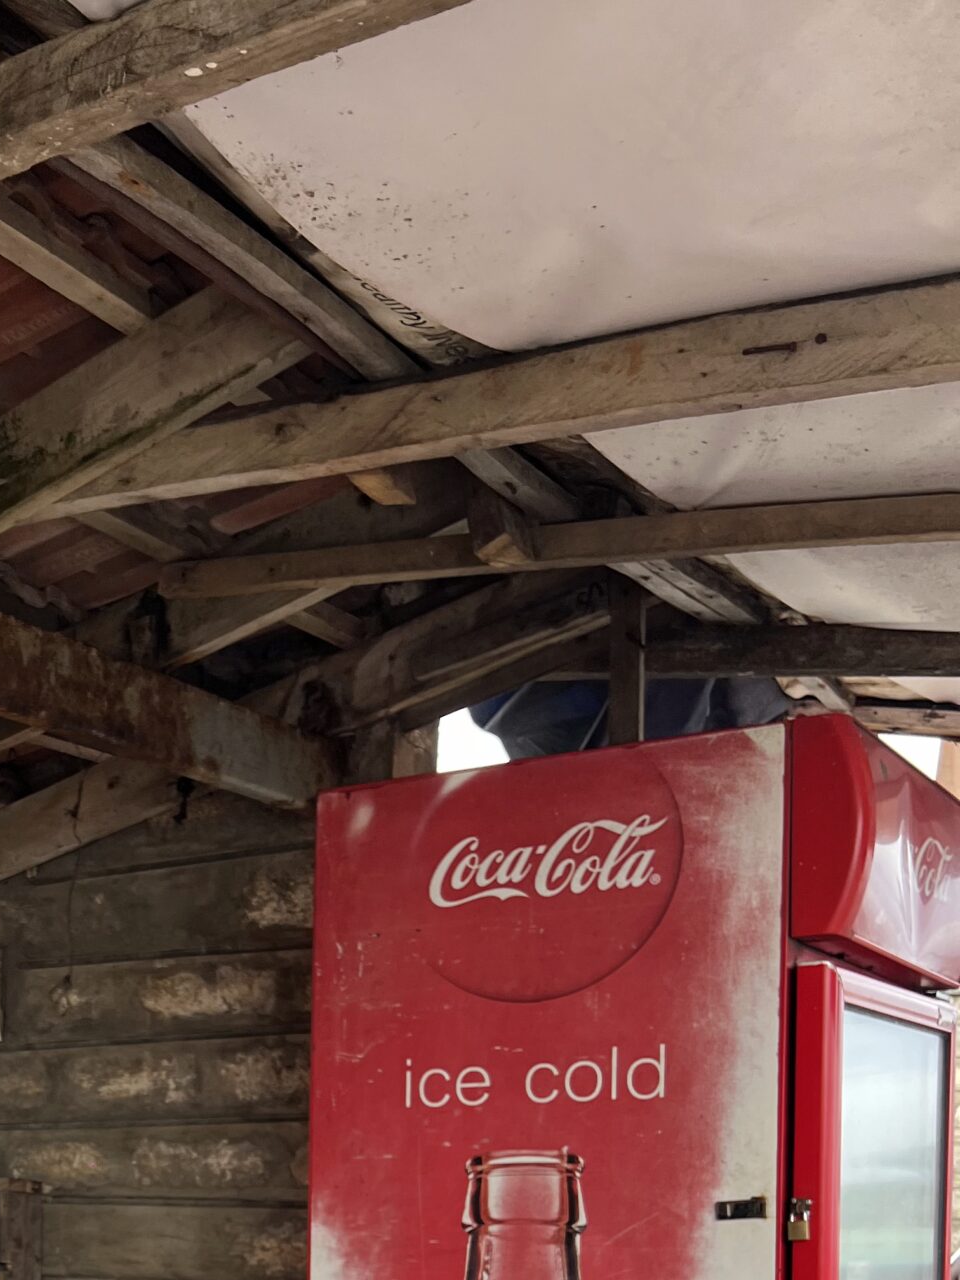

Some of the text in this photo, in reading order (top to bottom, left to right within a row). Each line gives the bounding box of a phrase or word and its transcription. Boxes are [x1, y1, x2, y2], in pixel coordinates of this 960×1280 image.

[353, 276, 436, 330] ealthy
[429, 814, 668, 908] Coca-Cola
[405, 1043, 666, 1109] ice cold
